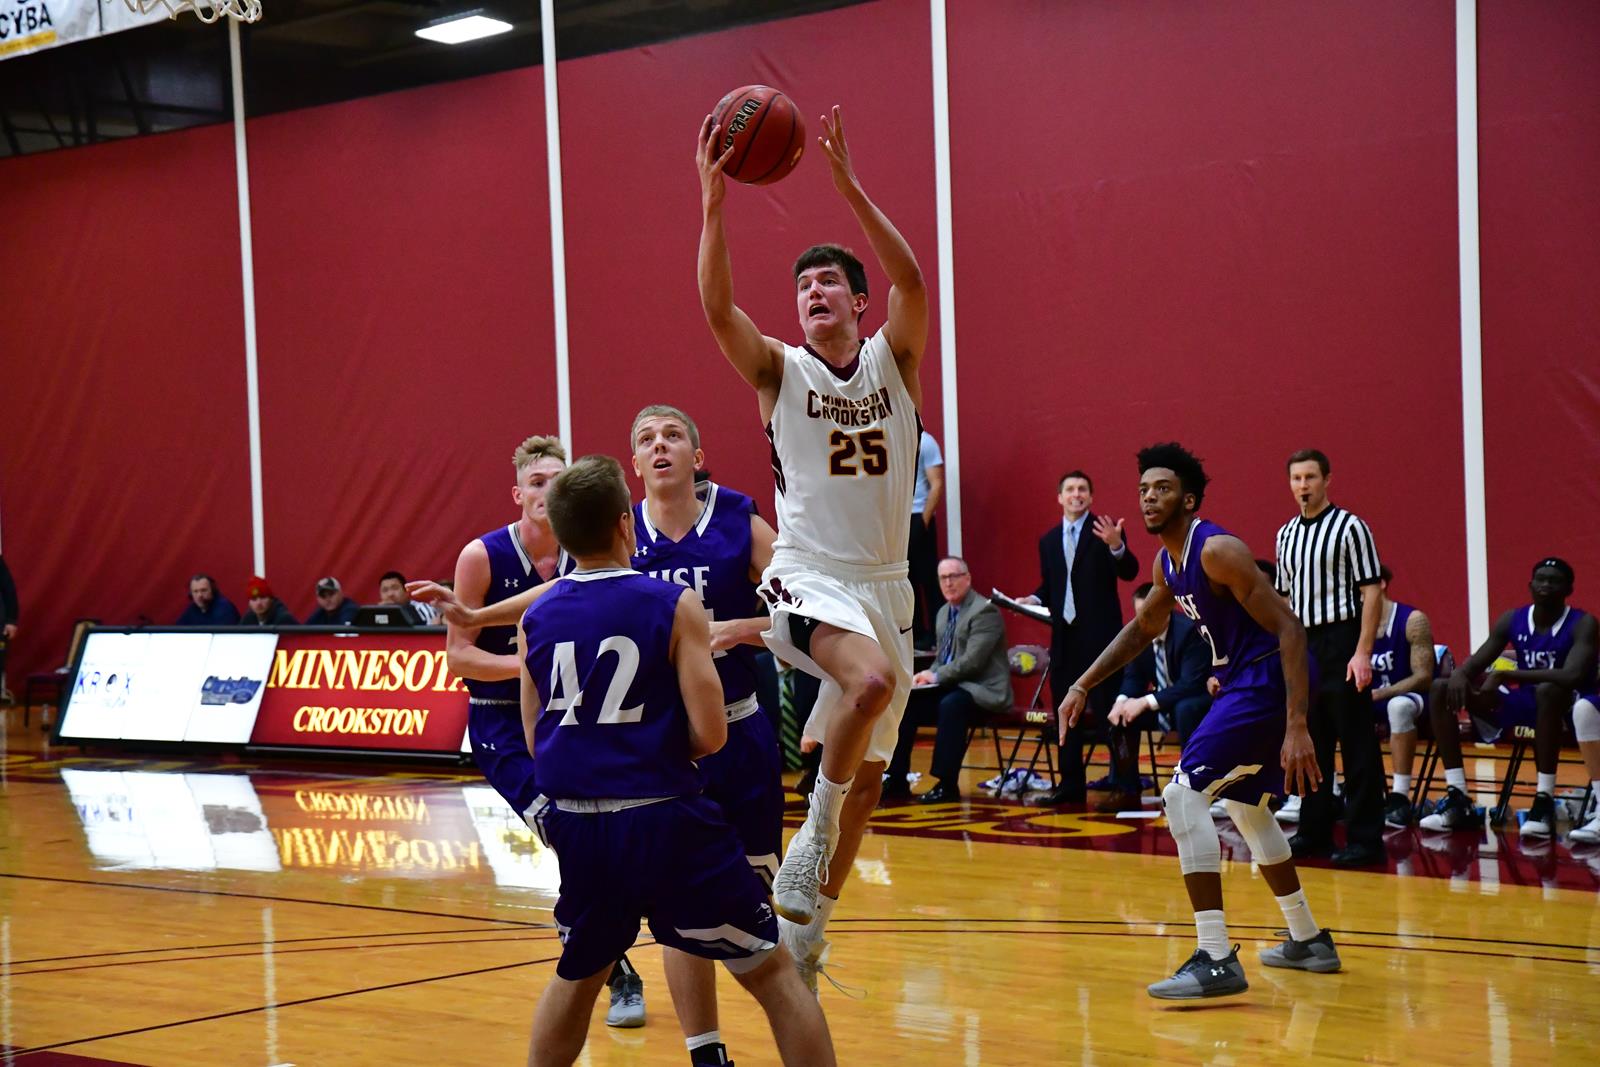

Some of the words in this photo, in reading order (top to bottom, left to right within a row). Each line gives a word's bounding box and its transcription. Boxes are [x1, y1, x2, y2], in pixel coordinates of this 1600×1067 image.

[723, 98, 762, 150] Wilso
[807, 386, 893, 427] CROOKSTON
[828, 428, 888, 476] 25
[545, 635, 645, 727] 42
[293, 705, 430, 736] CROOKSTON
[1025, 711, 1048, 724] UMC
[1514, 725, 1536, 739] UM
